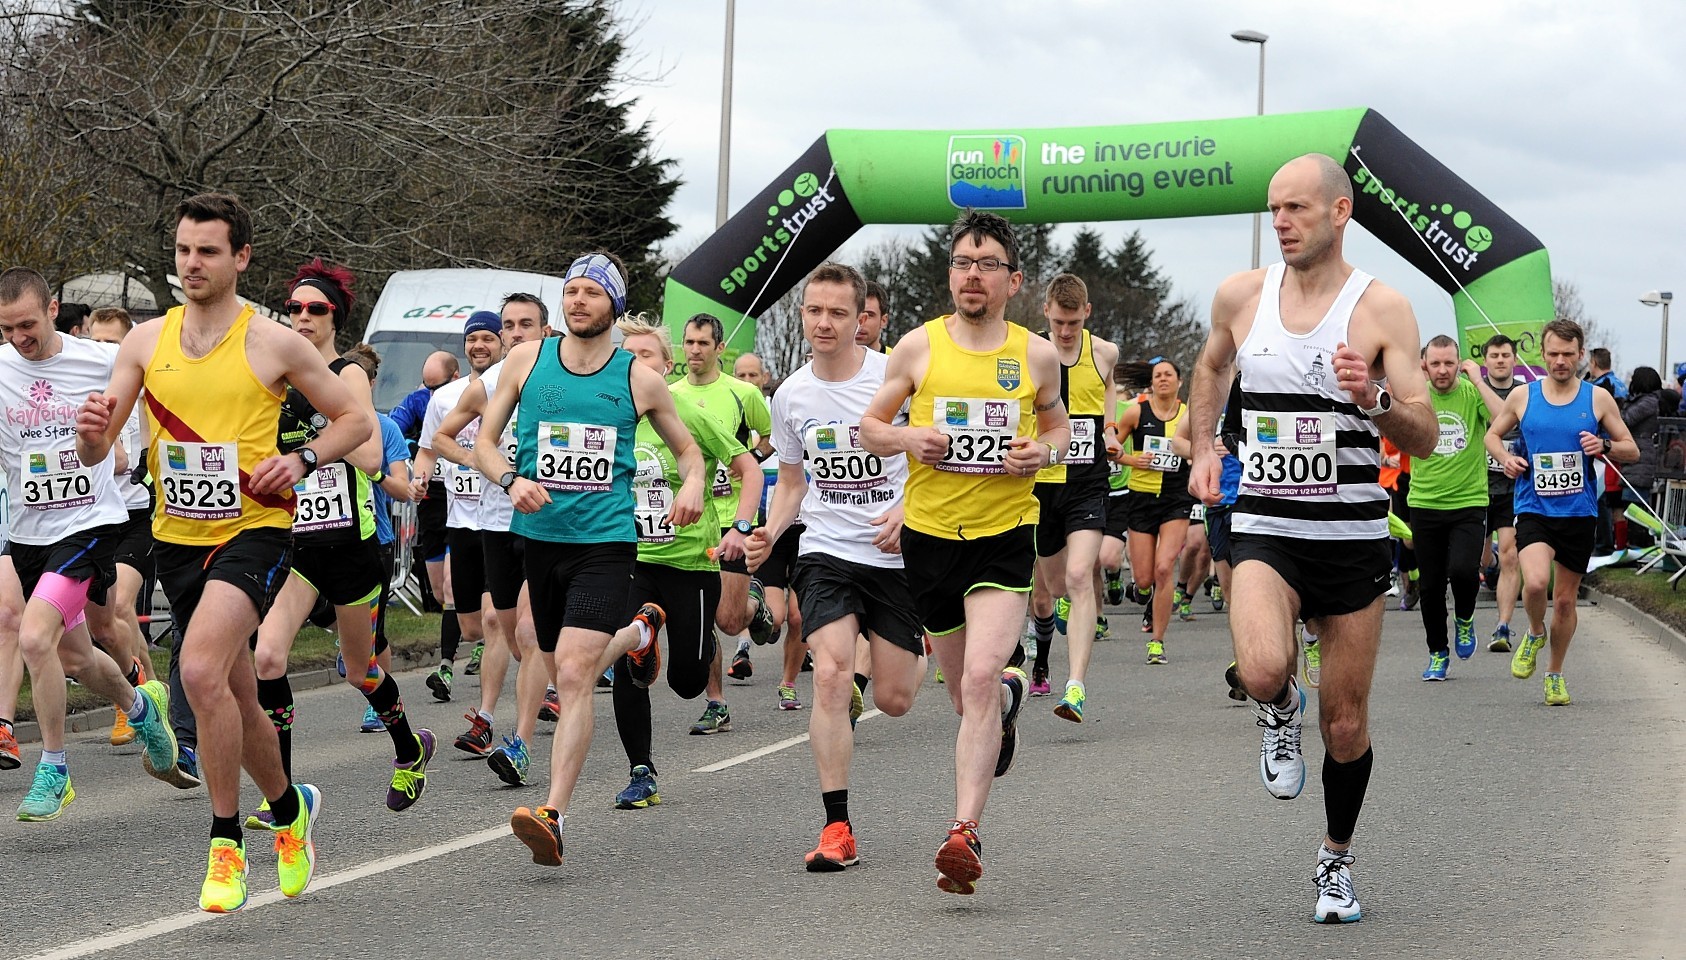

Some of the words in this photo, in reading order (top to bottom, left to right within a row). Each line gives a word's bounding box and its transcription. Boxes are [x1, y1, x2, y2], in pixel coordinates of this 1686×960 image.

[951, 149, 984, 164] run
[1041, 142, 1085, 165] the
[1095, 136, 1216, 163] inverurie
[951, 163, 1019, 180] Garioch
[1042, 169, 1144, 198] running
[1153, 162, 1234, 189] event
[45, 426, 77, 439] Stars
[540, 454, 609, 481] 3460
[814, 454, 882, 479] 3500
[1248, 452, 1332, 483] 3300
[25, 475, 90, 502] 3170
[164, 477, 236, 507] 3523
[1536, 472, 1581, 489] 3499
[871, 489, 894, 503] Race
